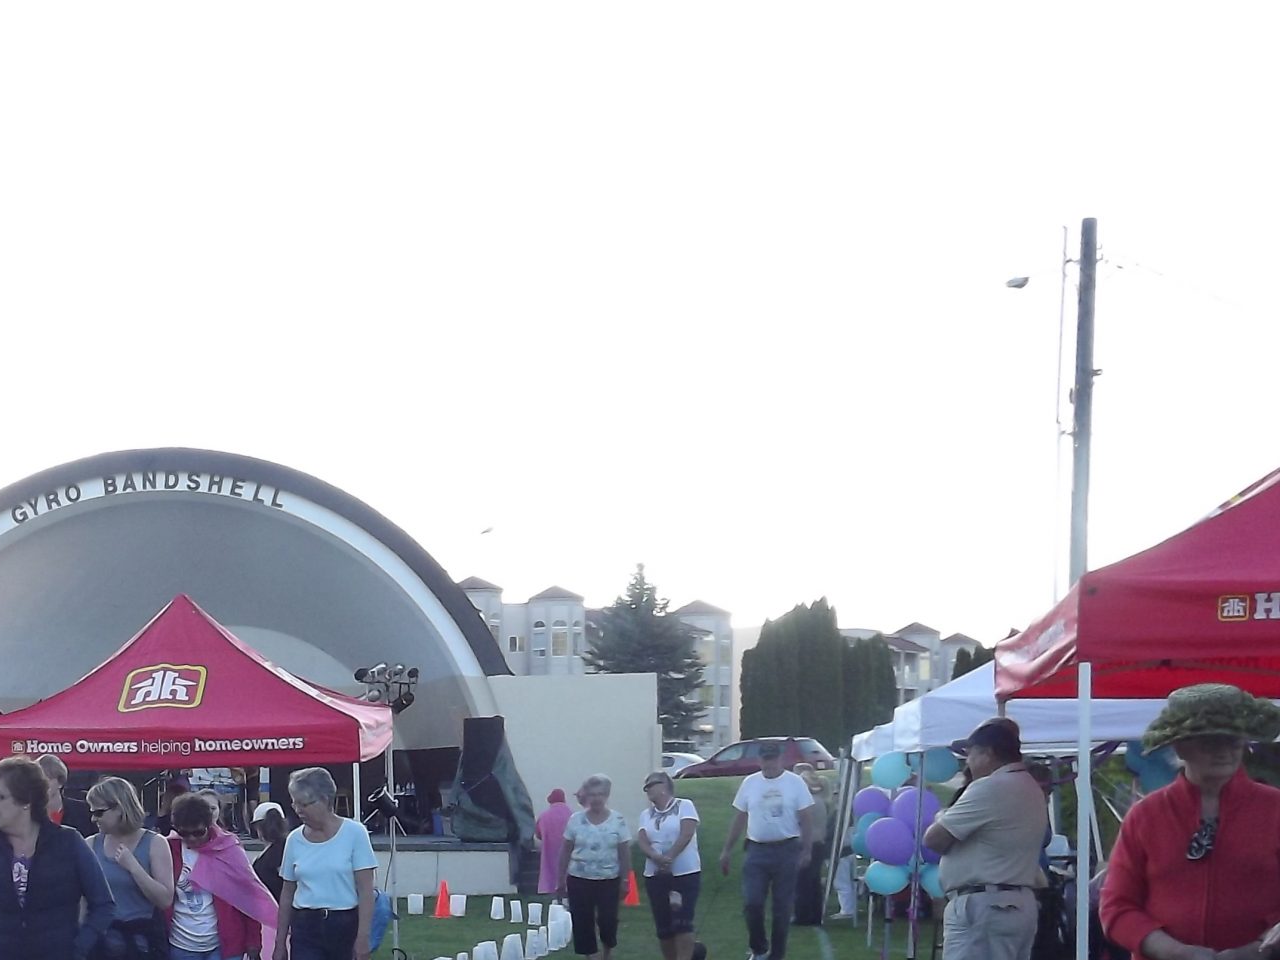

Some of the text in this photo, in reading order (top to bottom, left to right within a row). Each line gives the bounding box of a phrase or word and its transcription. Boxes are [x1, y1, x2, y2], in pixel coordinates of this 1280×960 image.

[11, 472, 284, 522] GYRO BANDSHELL
[26, 737, 304, 756] Home Owners helping homeowners
